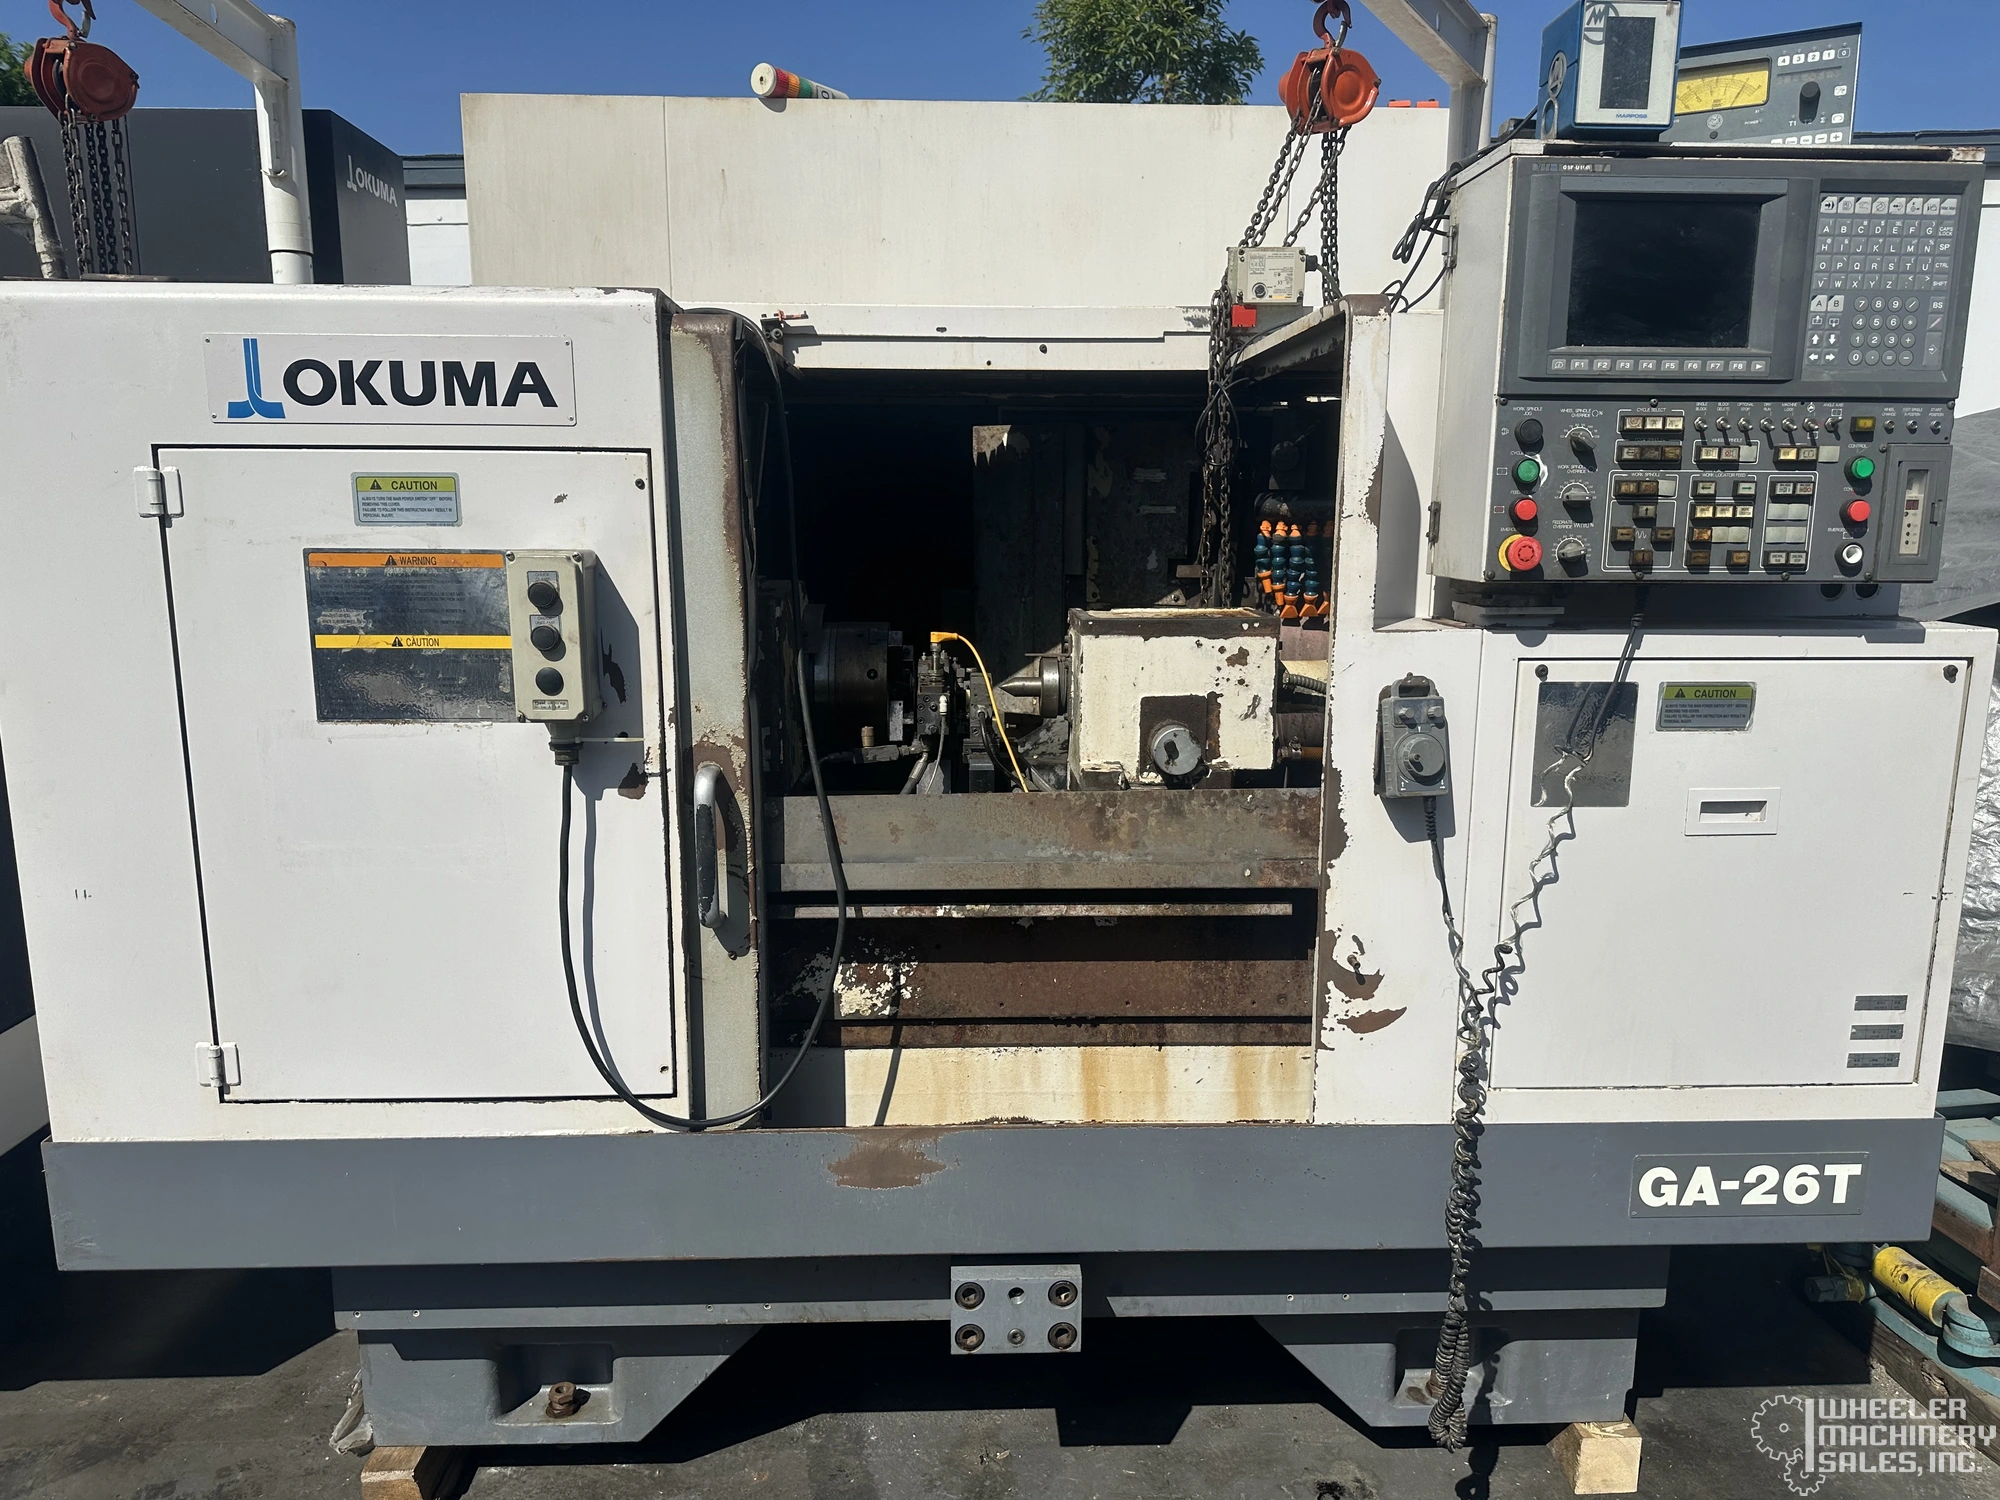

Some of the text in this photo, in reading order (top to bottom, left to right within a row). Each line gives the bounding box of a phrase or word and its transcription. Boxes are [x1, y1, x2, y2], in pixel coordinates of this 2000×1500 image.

[356, 167, 398, 207] OKUMA
[283, 358, 559, 408] OKUMA
[391, 480, 438, 490] CAUTION
[400, 556, 437, 566] WARNING
[406, 637, 440, 647] CAUTION
[1694, 689, 1736, 698] CAUTION
[1638, 1163, 1862, 1207] GA-26T
